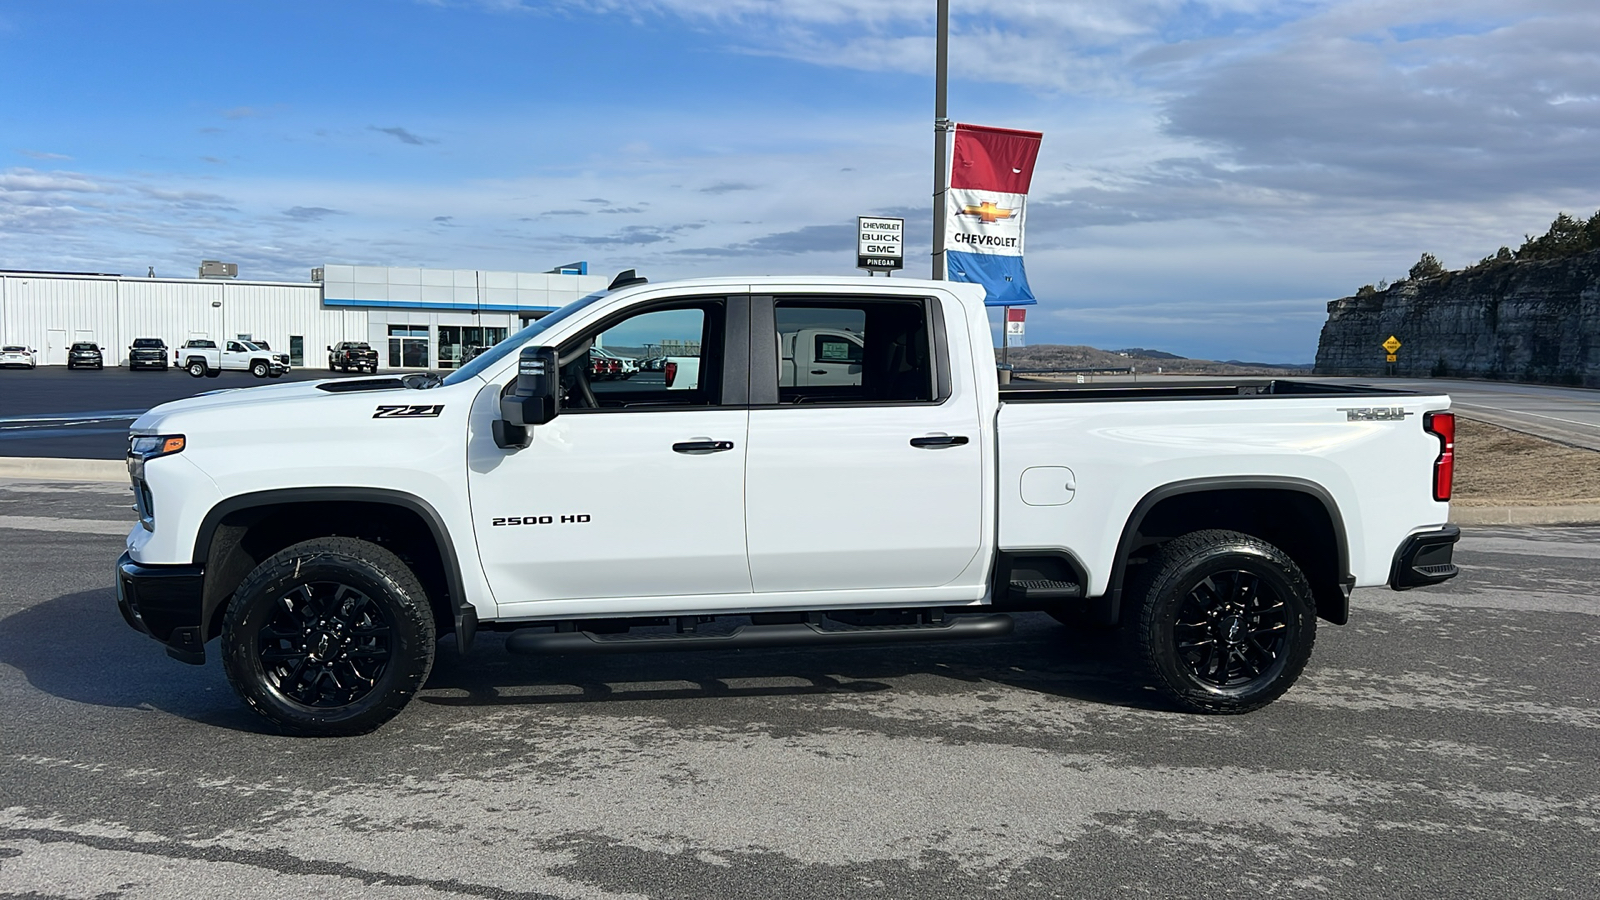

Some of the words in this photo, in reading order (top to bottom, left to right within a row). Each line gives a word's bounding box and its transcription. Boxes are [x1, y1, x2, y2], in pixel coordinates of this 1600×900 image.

[862, 222, 900, 231] CHEVROLET
[862, 233, 900, 242] BUICK
[954, 232, 1017, 247] CHEVROLET
[867, 245, 895, 254] GMC
[867, 258, 895, 266] PINEGAR
[372, 404, 445, 419] Z71
[492, 516, 553, 527] 2500
[560, 514, 591, 524] HD
